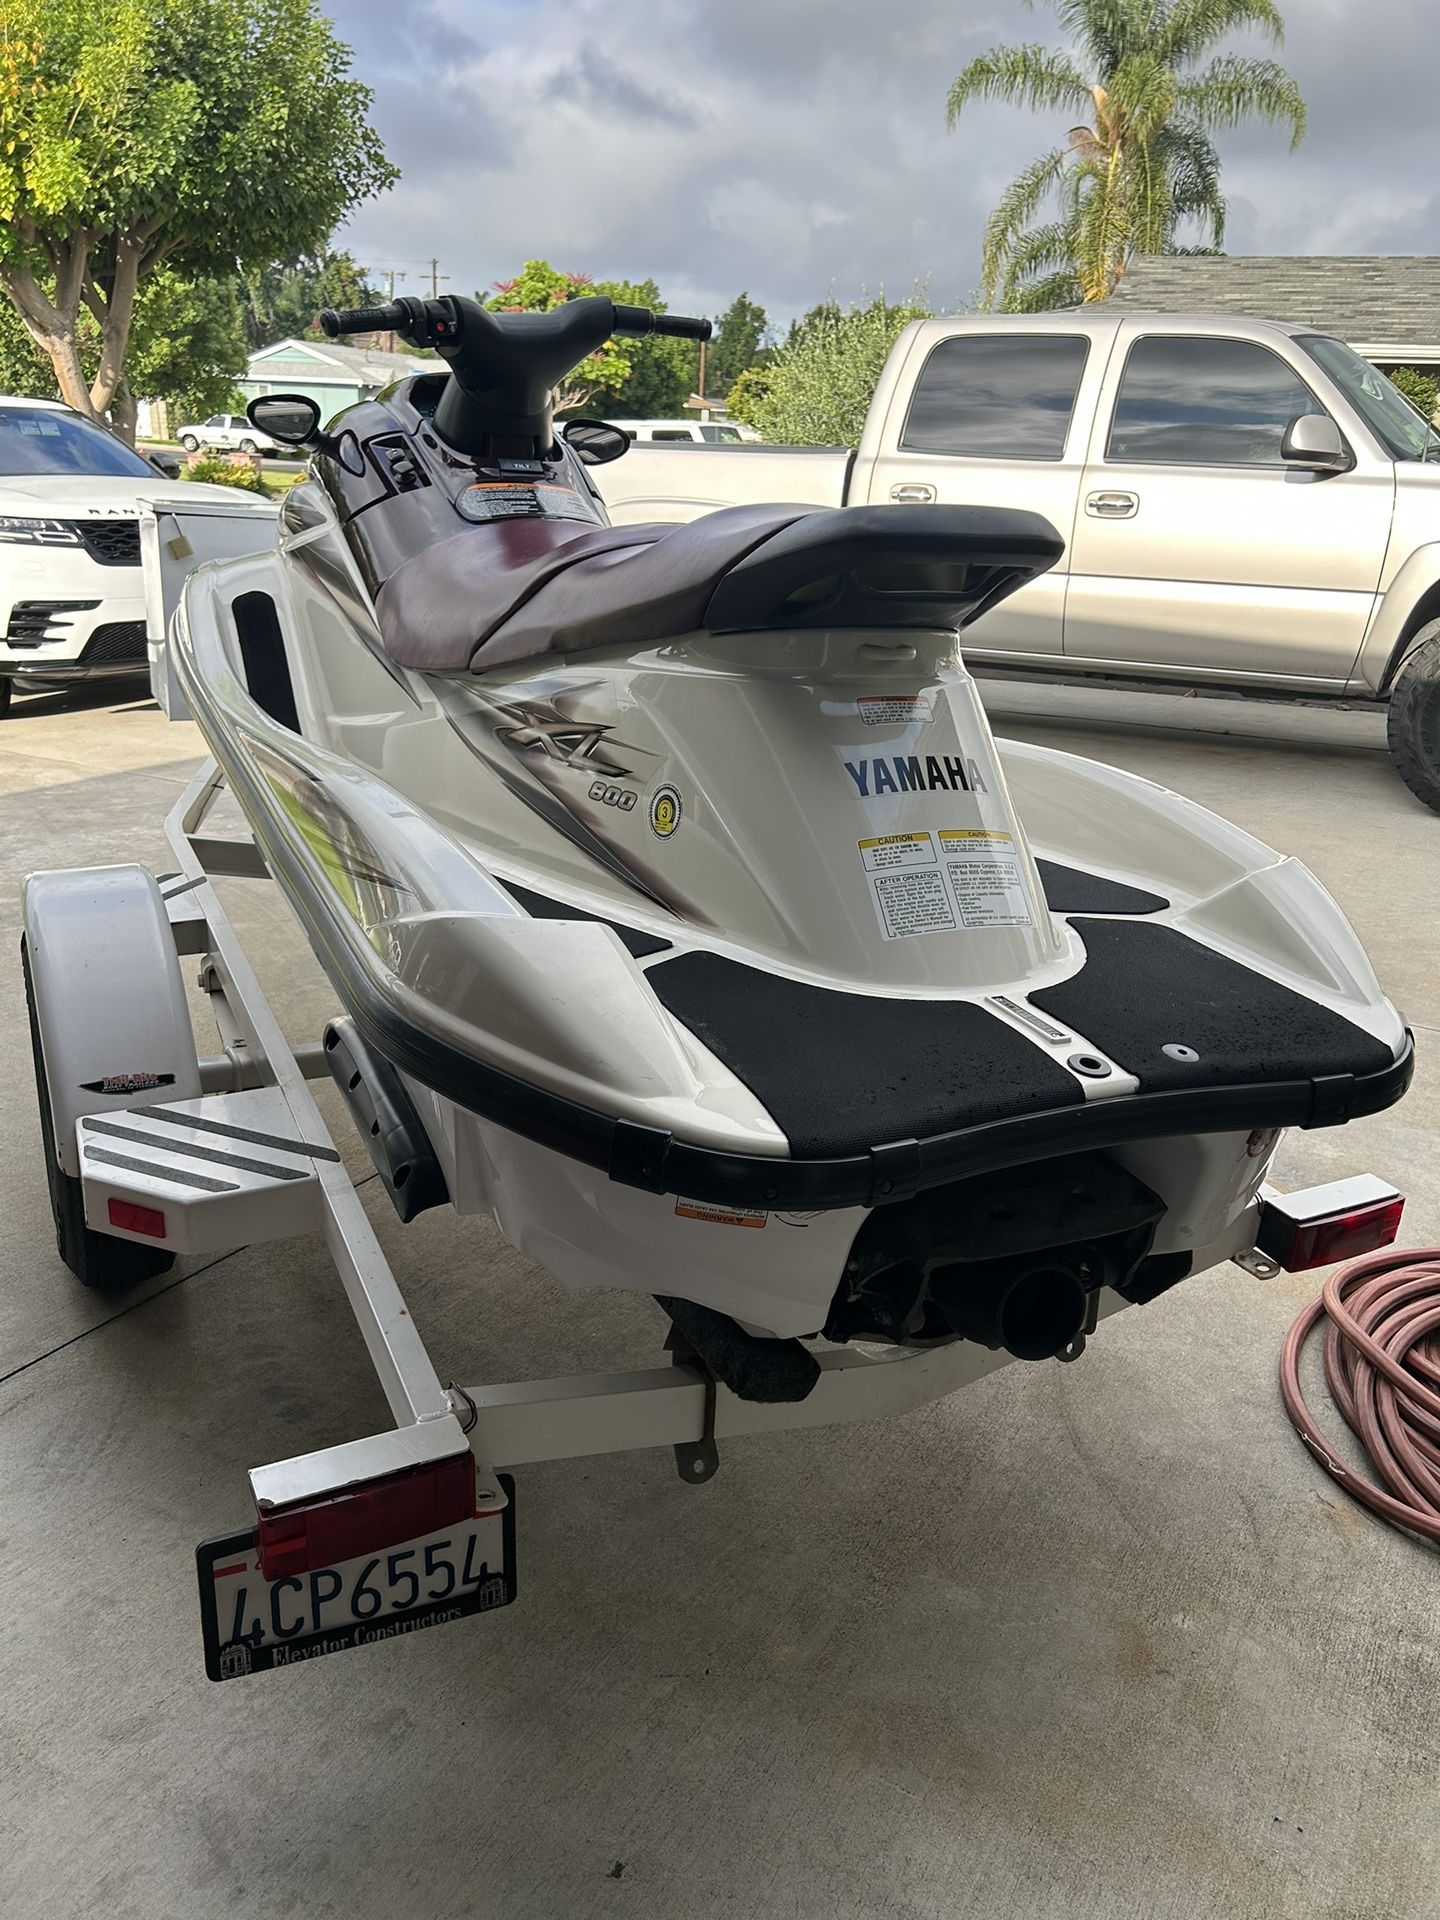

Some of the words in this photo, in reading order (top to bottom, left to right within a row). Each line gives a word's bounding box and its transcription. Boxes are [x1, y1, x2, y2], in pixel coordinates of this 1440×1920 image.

[844, 756, 989, 797] YAMAHA
[588, 781, 638, 812] 800
[878, 834, 914, 845] CAUTION
[902, 873, 938, 881] OPERATION
[696, 1212, 736, 1224] WARNING
[232, 1534, 488, 1643] 4CP6554
[272, 1637, 349, 1667] Elevator
[354, 1606, 462, 1646] Constructors
